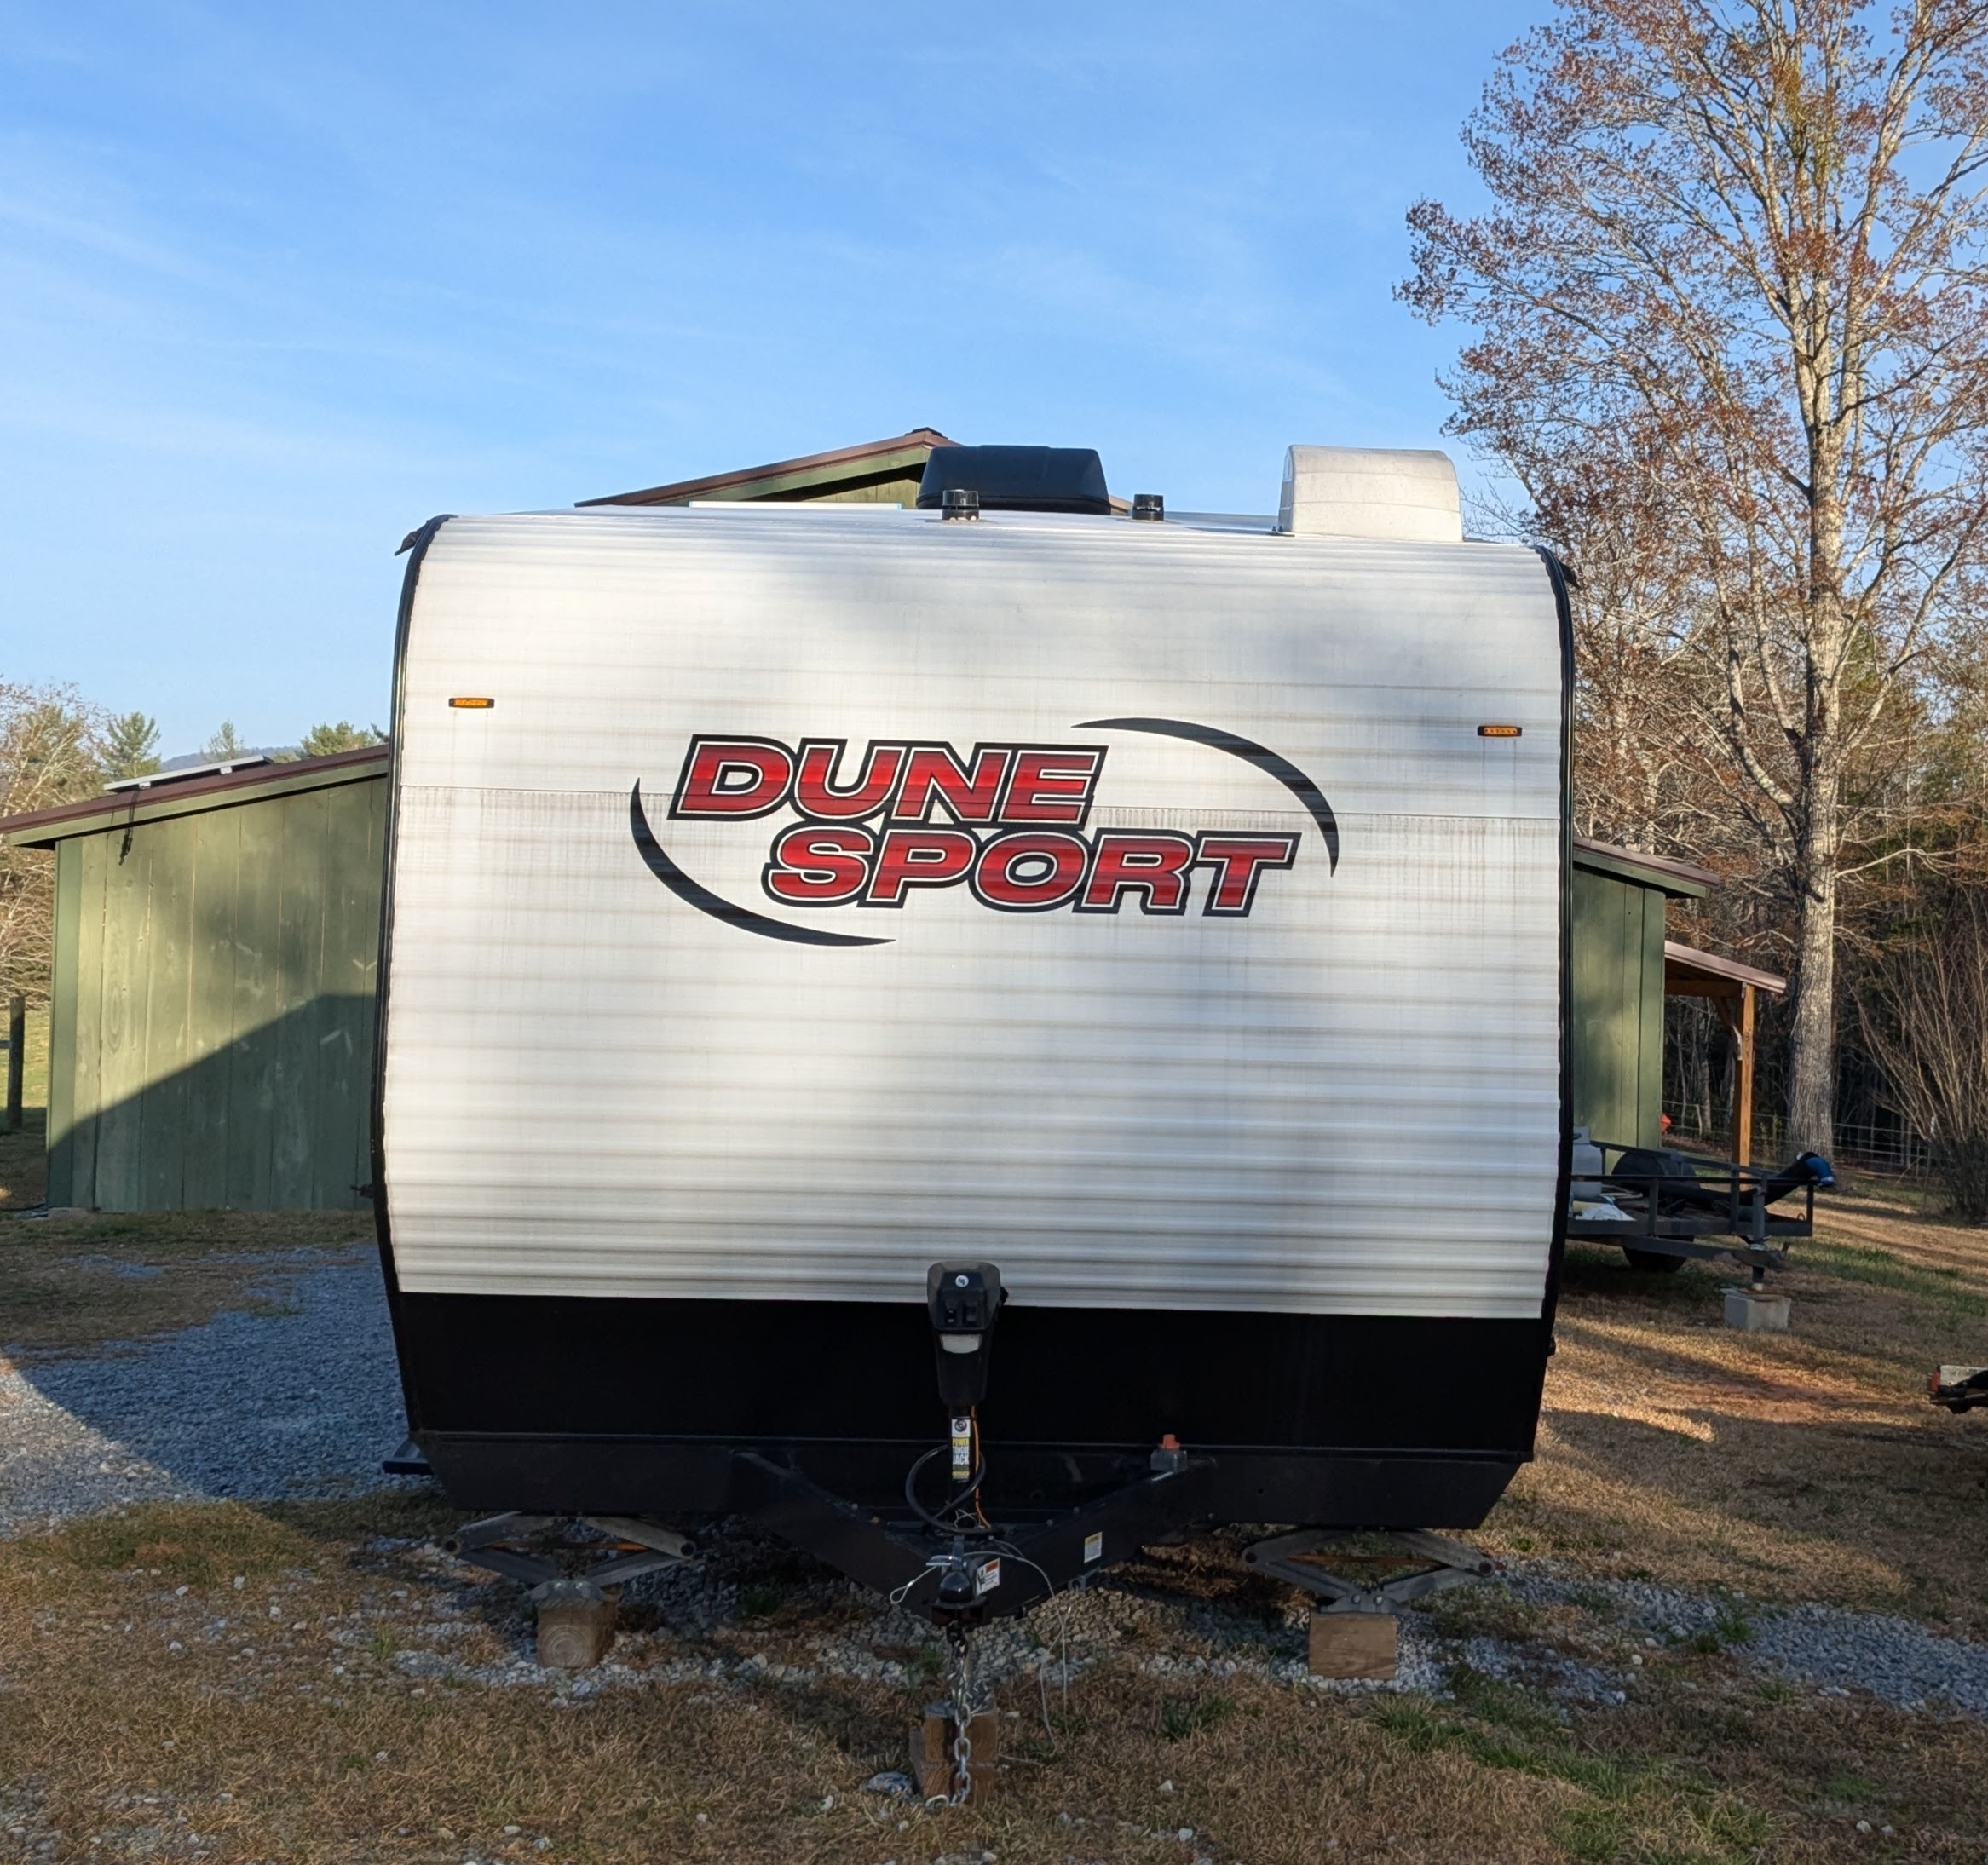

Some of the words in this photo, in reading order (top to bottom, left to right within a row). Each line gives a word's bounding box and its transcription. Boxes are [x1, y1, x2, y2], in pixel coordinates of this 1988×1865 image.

[667, 734, 1108, 828] DUNE
[762, 822, 1301, 917] SPORT
[953, 1453, 970, 1465] JACK
